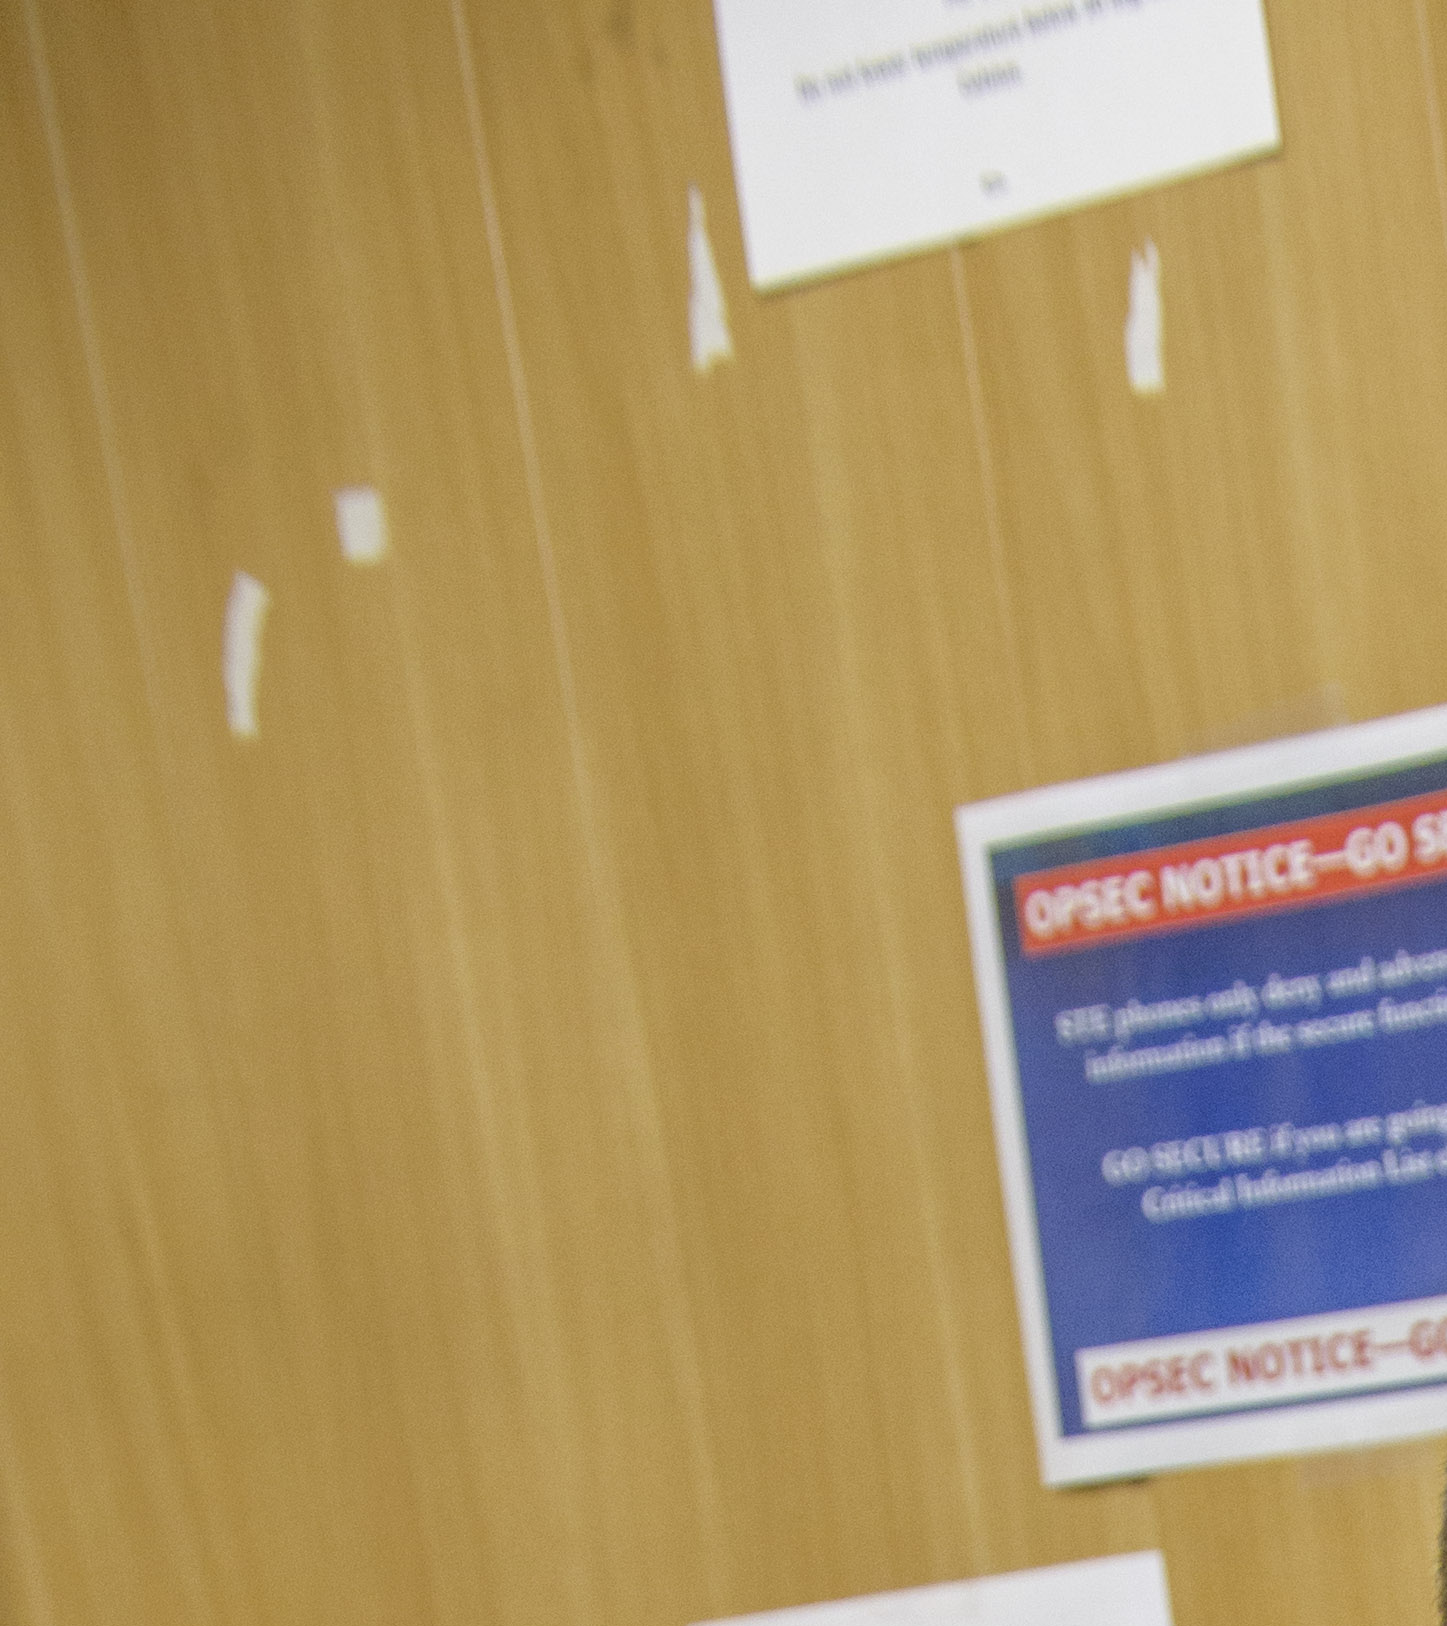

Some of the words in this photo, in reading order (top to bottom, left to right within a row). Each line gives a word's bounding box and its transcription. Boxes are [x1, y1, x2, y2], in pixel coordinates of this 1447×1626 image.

[1023, 869, 1156, 940] OPSEC
[1327, 955, 1376, 1000] and
[1085, 1032, 1230, 1084] information
[1255, 1019, 1292, 1056] the
[1101, 1146, 1150, 1188] GO
[1151, 1126, 1269, 1182] SECURE
[1295, 1122, 1343, 1164] you
[1141, 1174, 1235, 1225] Critical
[1235, 1157, 1381, 1211] Information
[1090, 1349, 1215, 1405] OPSEC
